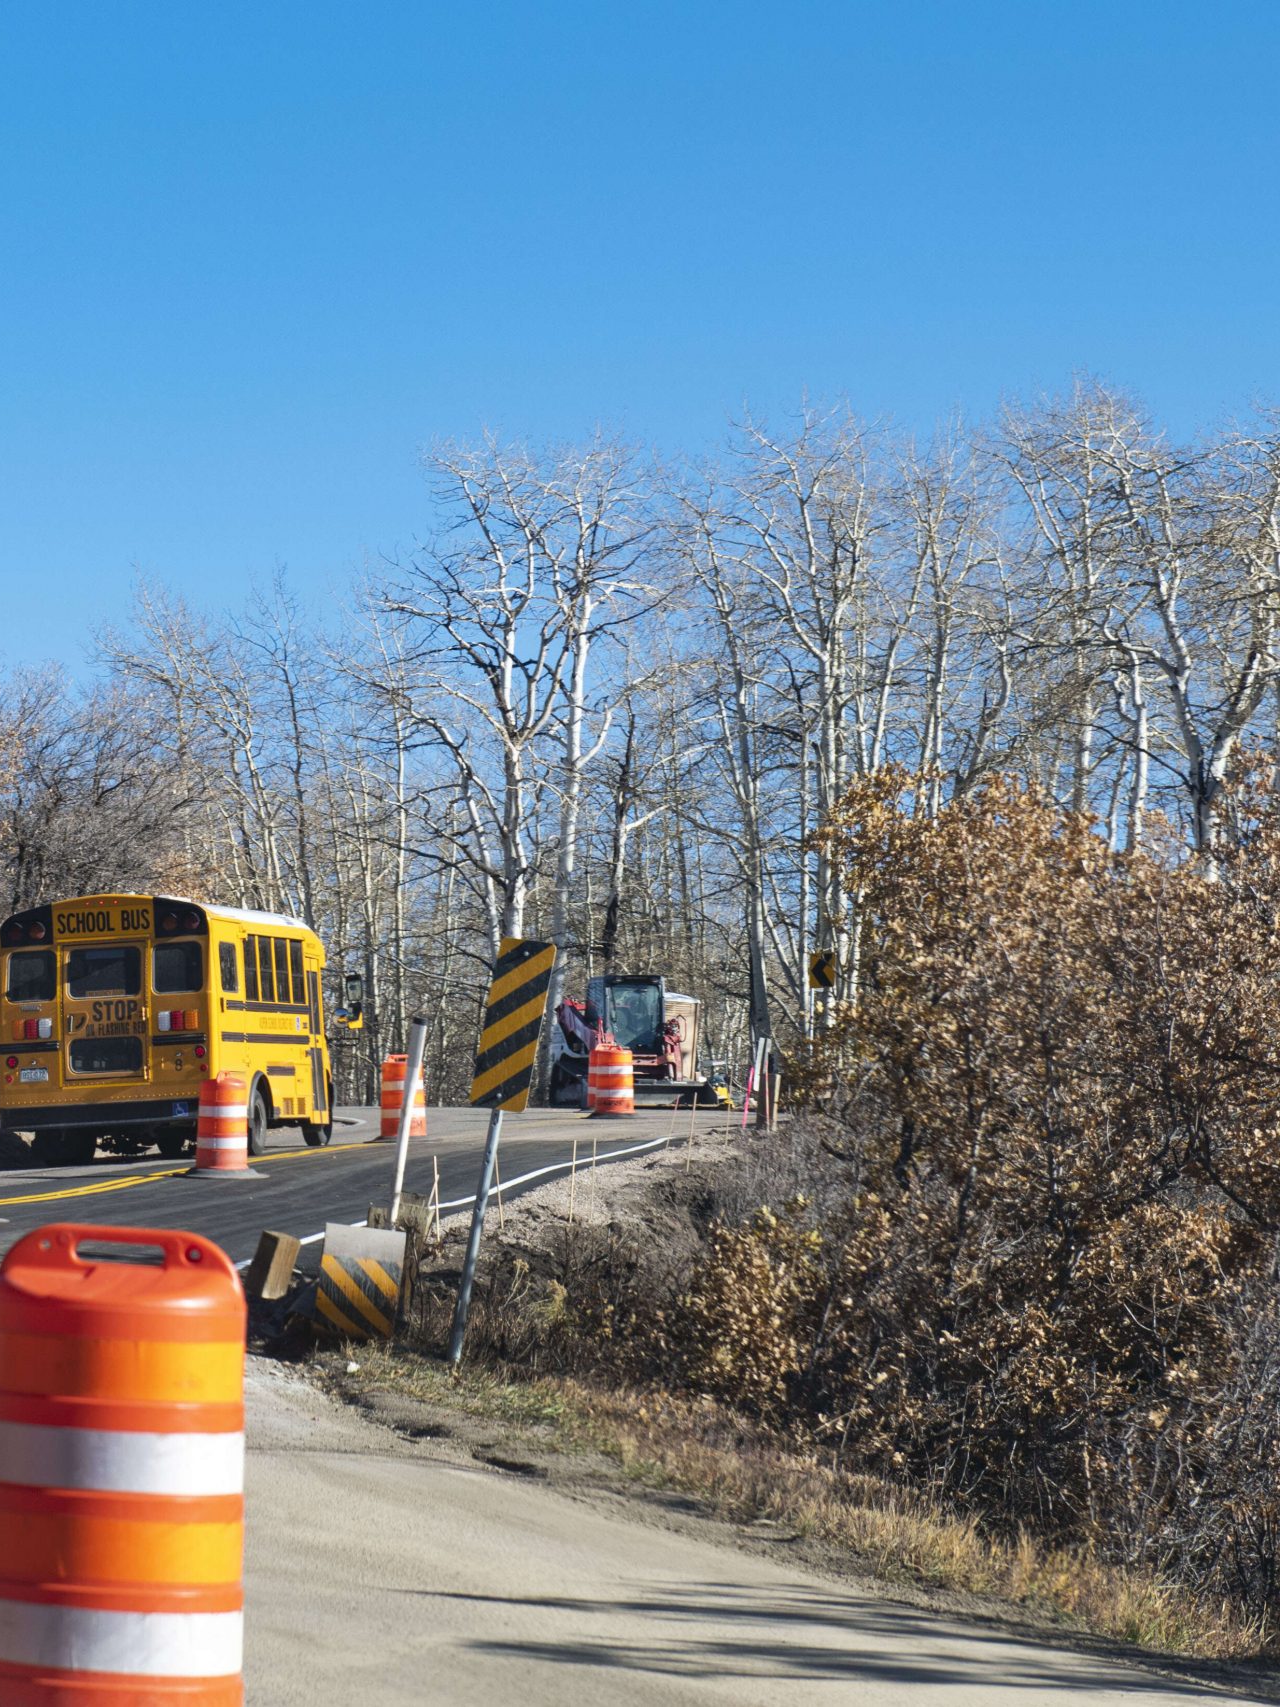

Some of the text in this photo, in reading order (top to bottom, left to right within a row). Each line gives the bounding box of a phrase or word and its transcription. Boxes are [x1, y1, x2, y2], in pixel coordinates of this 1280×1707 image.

[57, 908, 150, 934] SCHOOL BUS
[92, 1000, 137, 1022] STOP
[98, 1020, 130, 1037] FLASHING
[175, 1058, 183, 1071] 8
